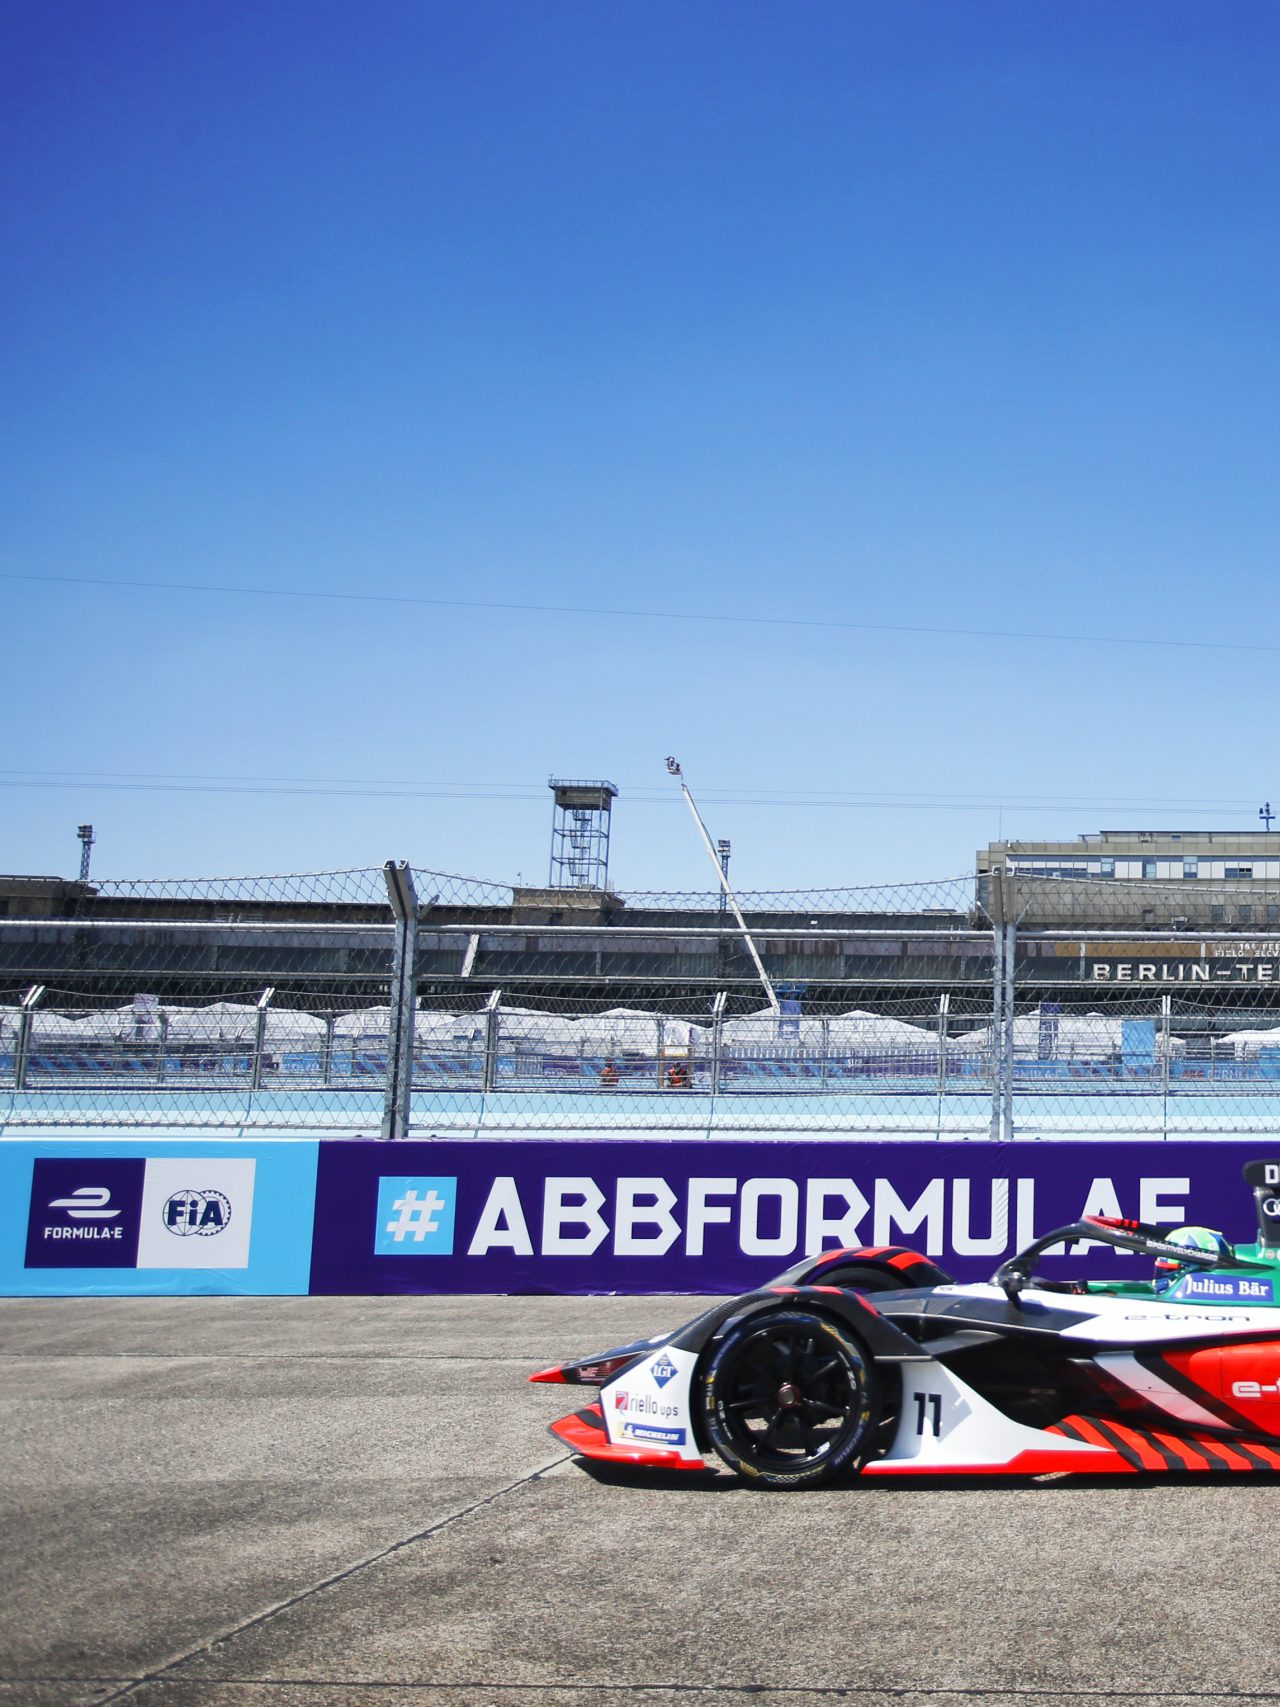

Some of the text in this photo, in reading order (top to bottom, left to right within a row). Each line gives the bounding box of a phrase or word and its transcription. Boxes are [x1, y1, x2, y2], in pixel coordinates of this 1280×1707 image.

[1186, 1274, 1269, 1297] Julius Bär
[652, 1364, 674, 1378] LGT
[631, 1394, 679, 1419] riello ups
[913, 1391, 942, 1437] 11
[634, 1429, 680, 1441] MICHELIN
